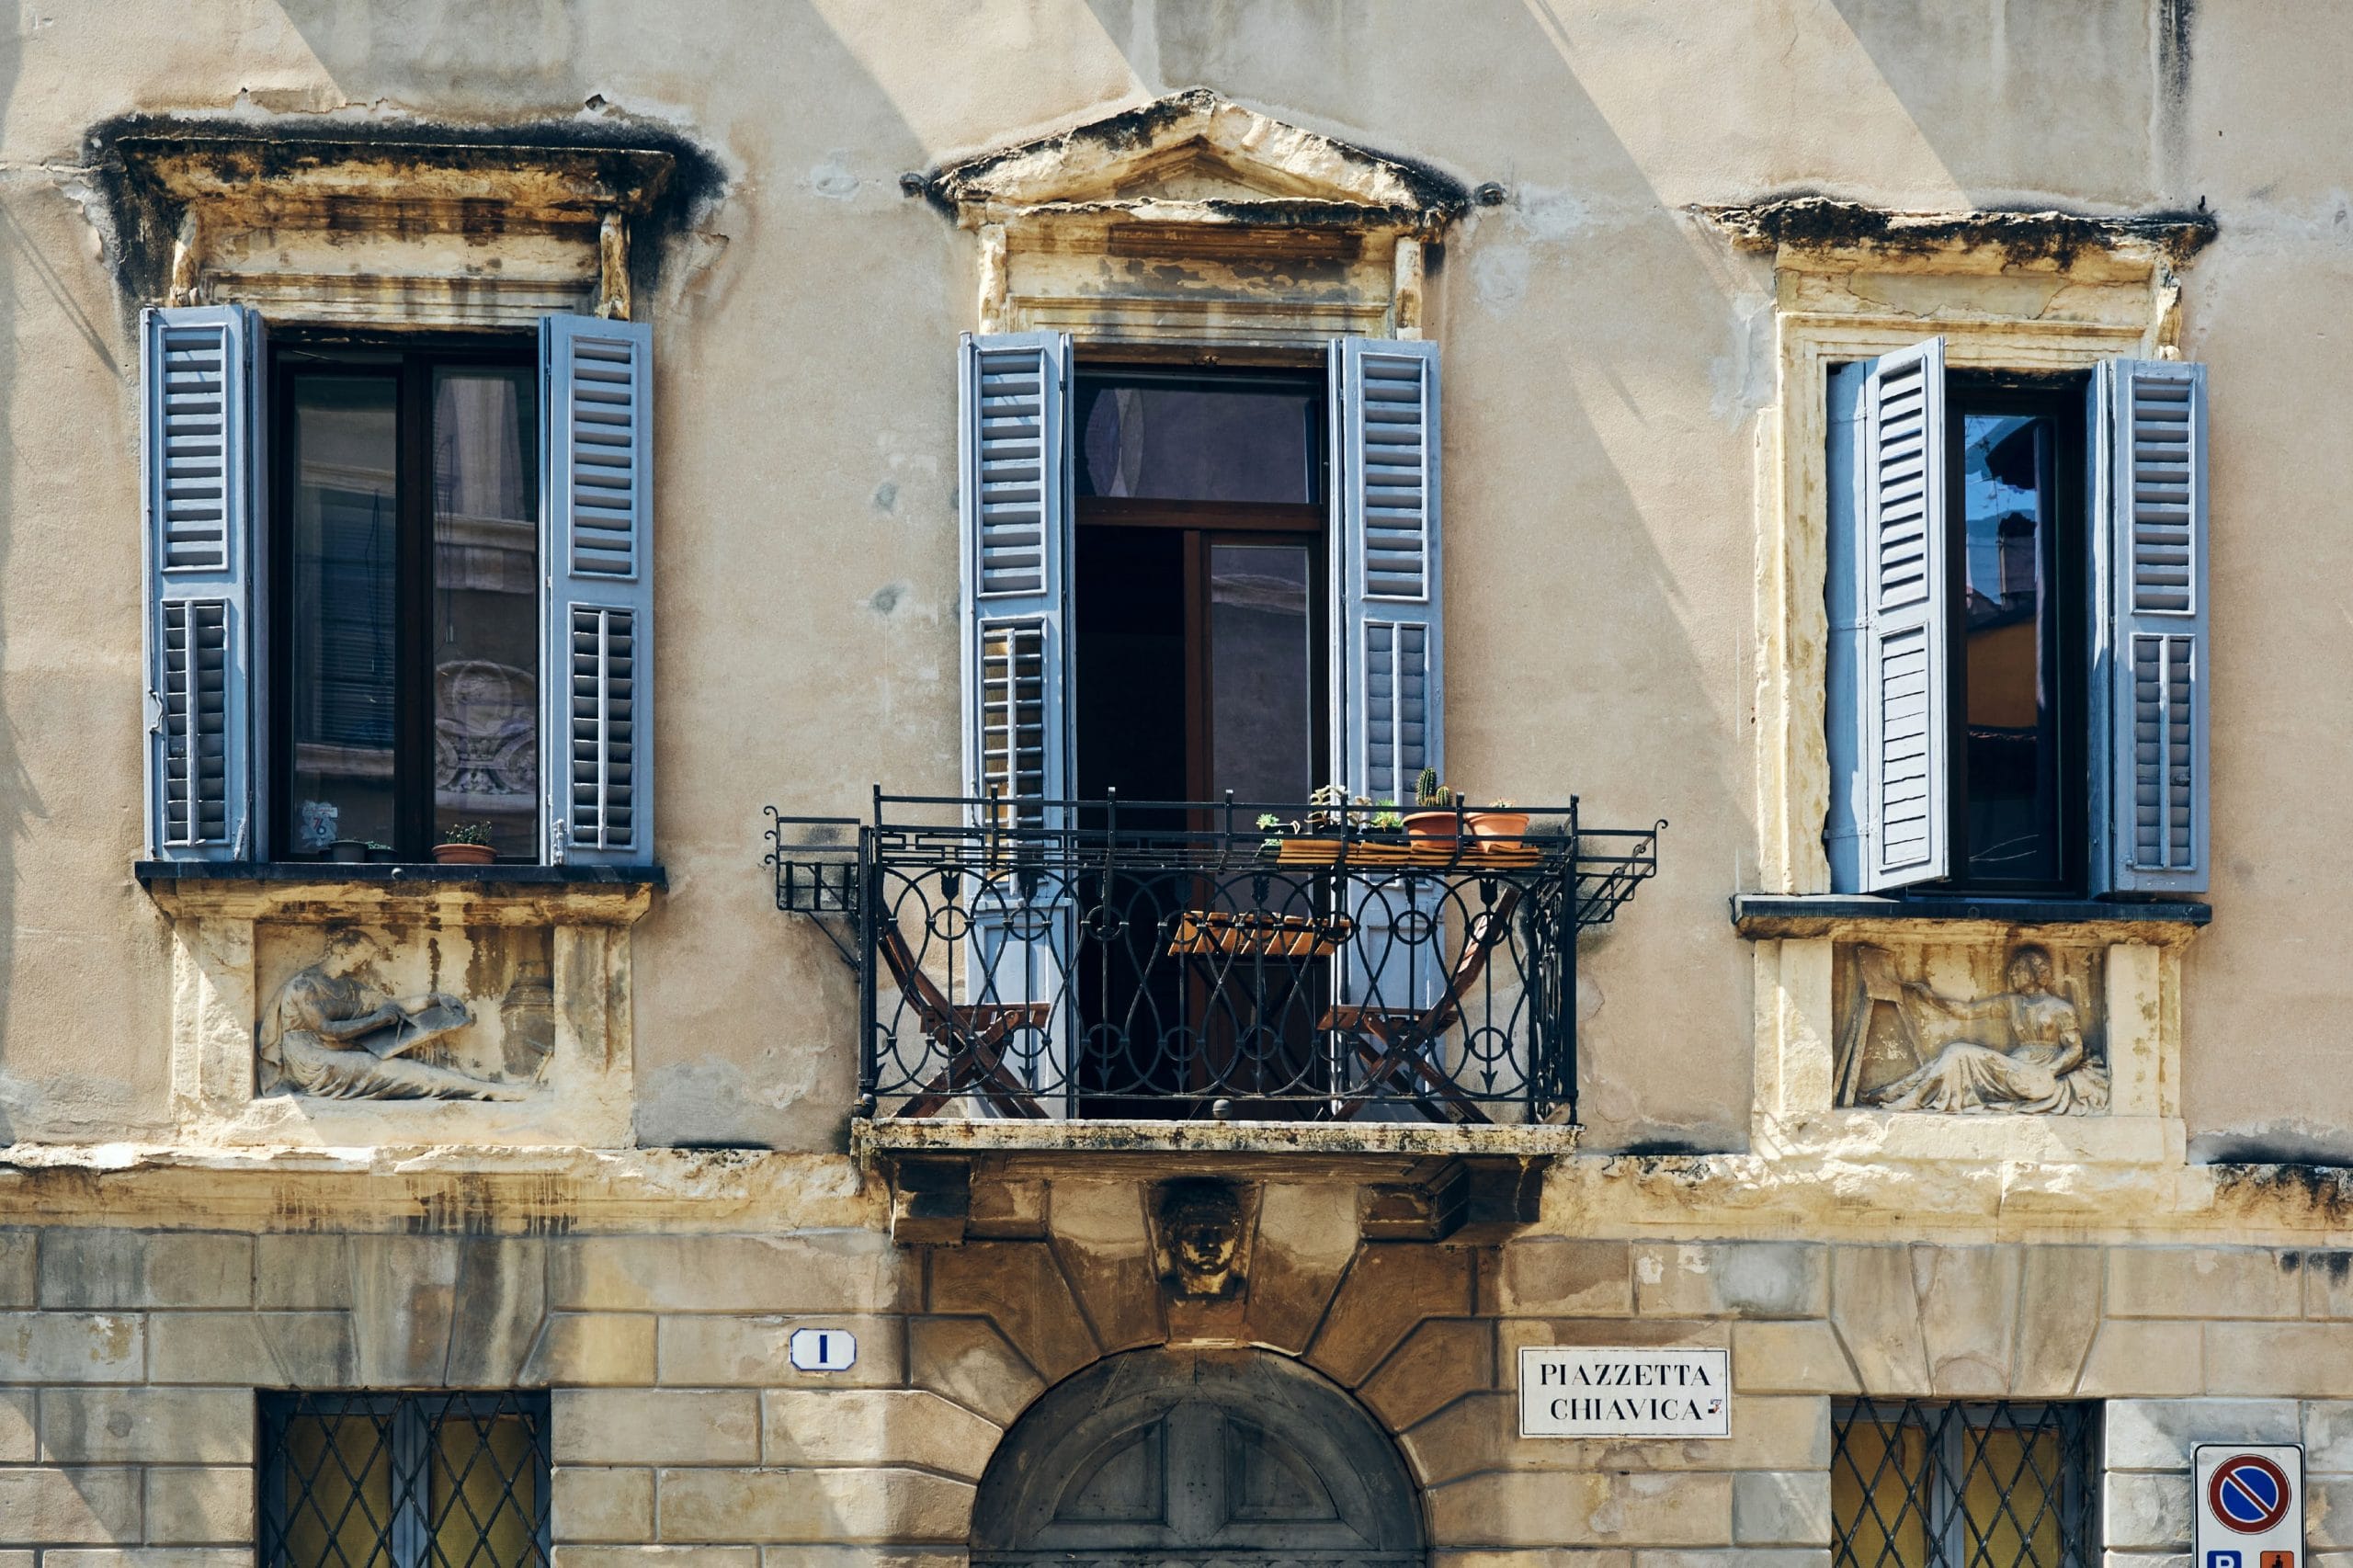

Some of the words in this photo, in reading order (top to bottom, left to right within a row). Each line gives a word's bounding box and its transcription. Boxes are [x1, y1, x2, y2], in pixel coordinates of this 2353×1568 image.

[1540, 1364, 1711, 1386] PIAZZETTA
[1551, 1398, 1703, 1420] CHIAVICA
[2216, 1555, 2234, 1568] P
